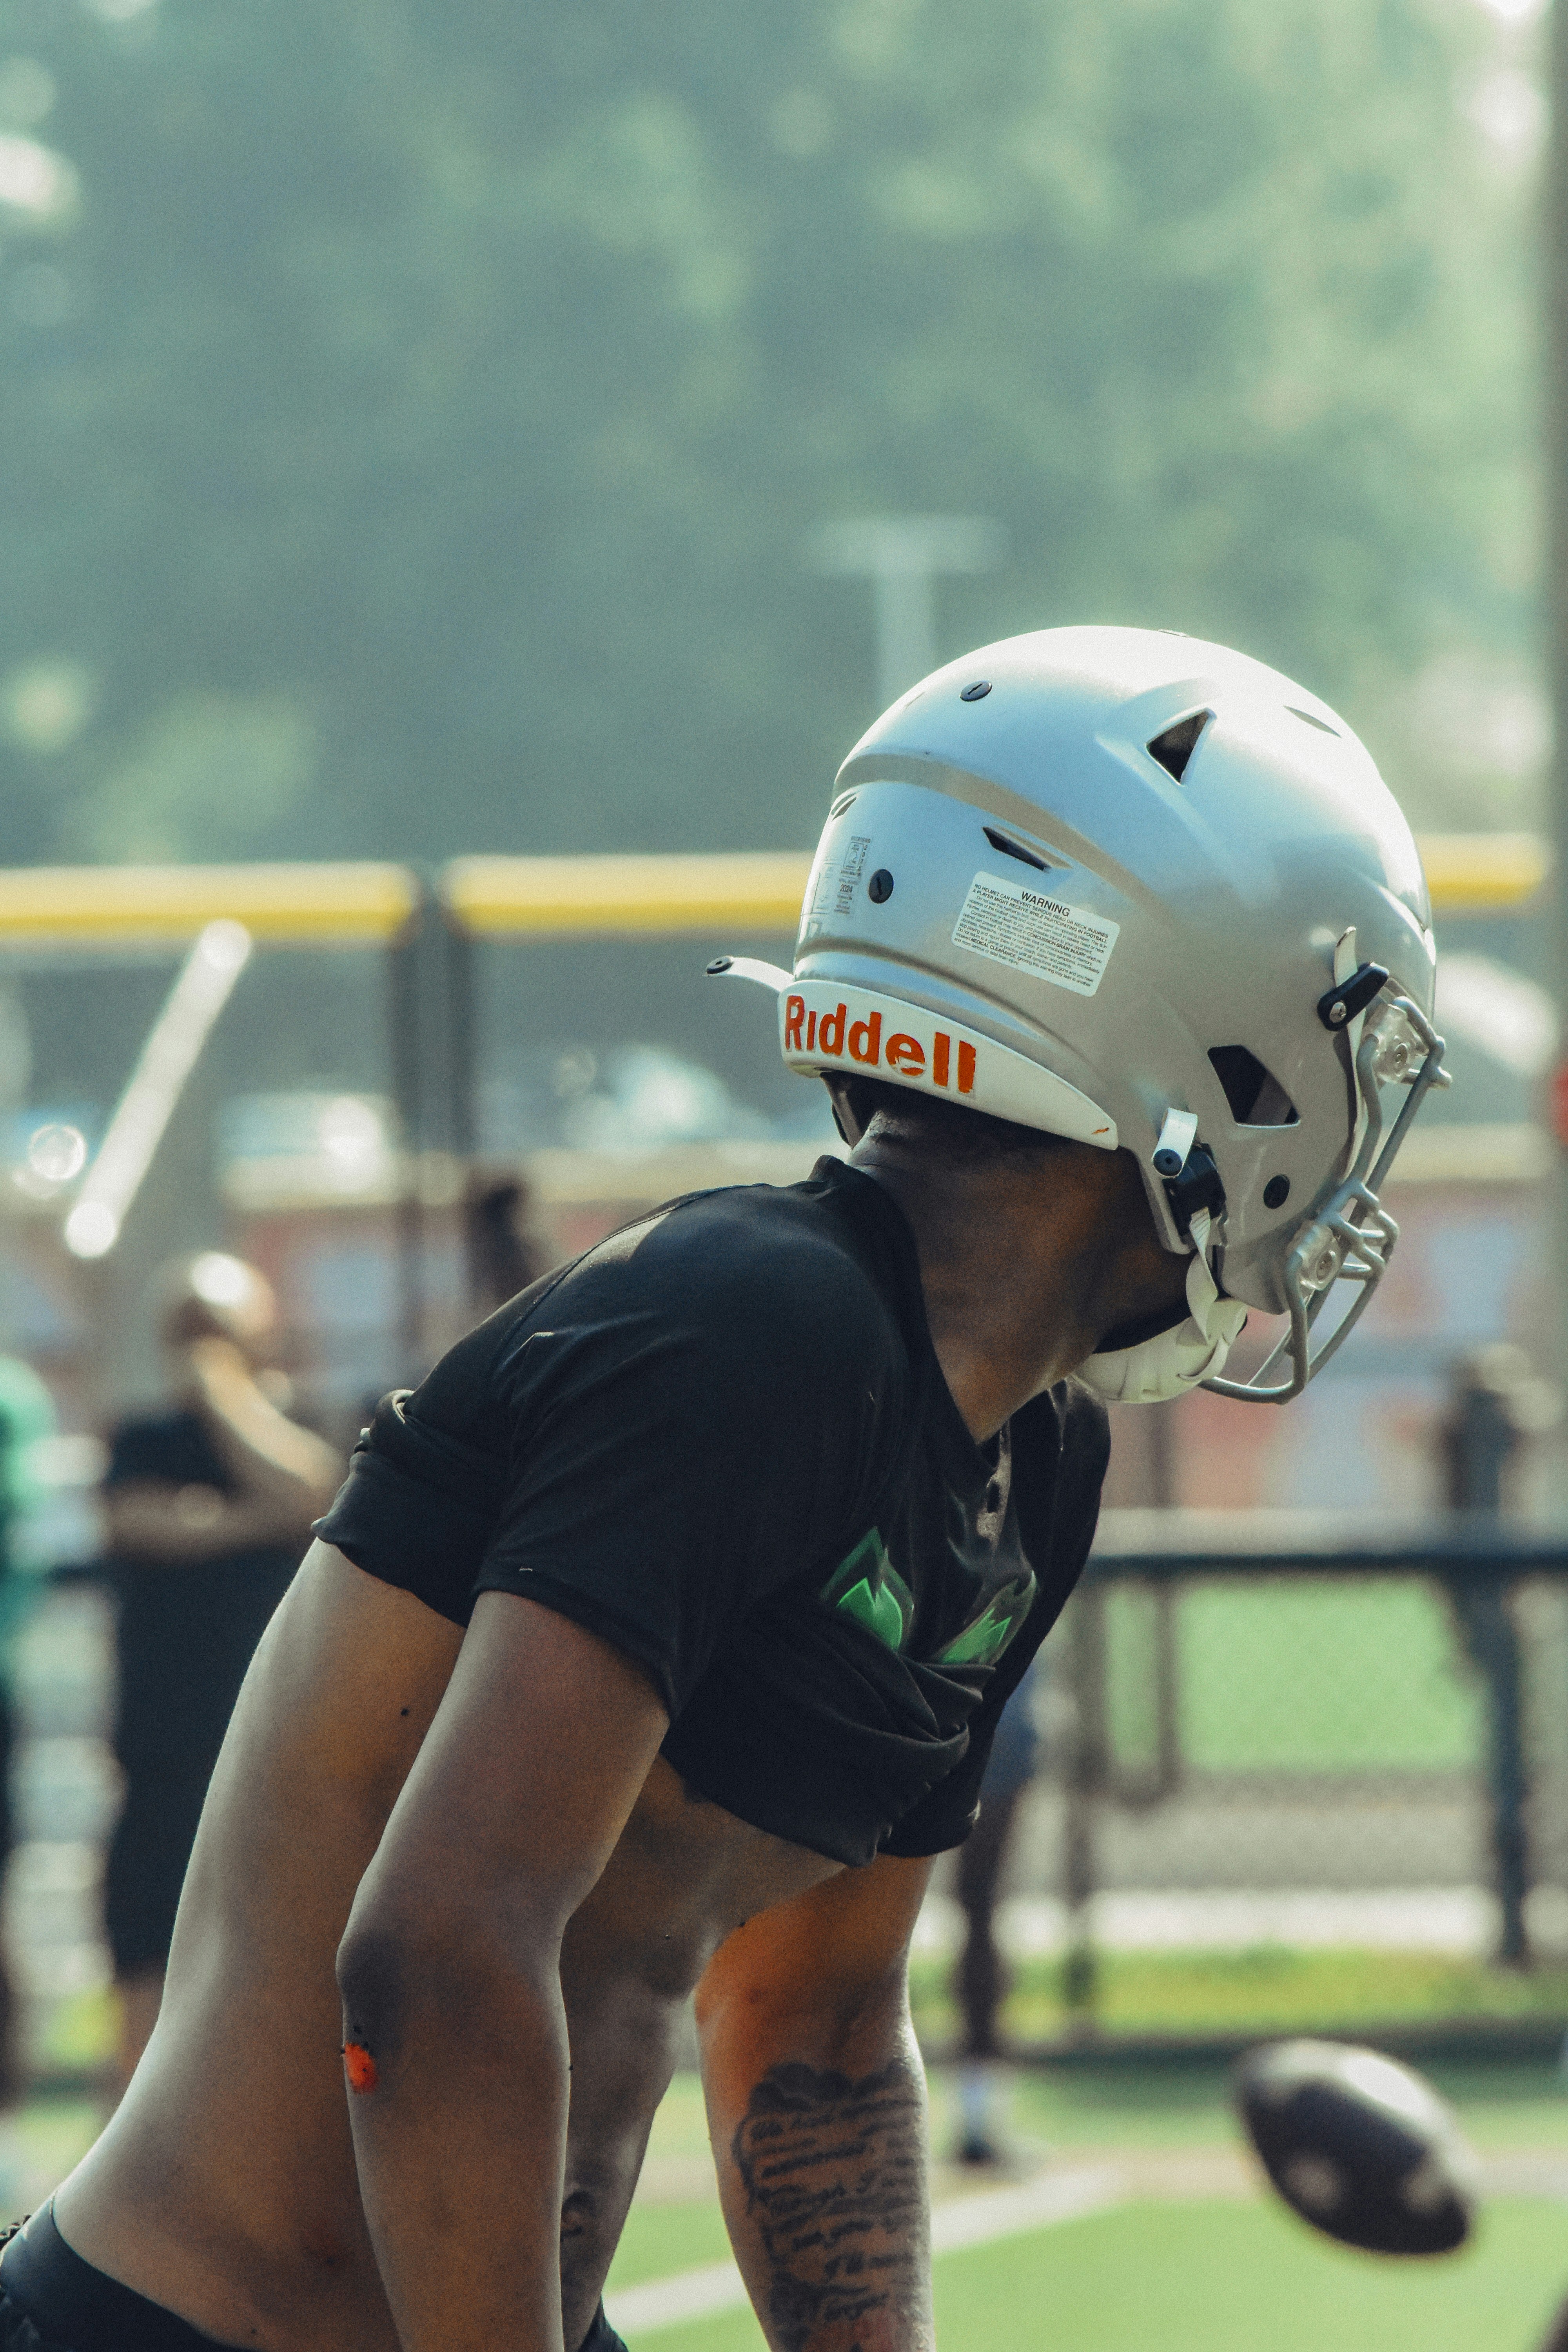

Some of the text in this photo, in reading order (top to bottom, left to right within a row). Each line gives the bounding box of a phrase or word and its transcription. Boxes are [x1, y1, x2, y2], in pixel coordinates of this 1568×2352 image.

[840, 884, 853, 893] 2024
[977, 890, 994, 899] PLAYER
[994, 897, 1008, 905] MIGHT
[1009, 903, 1028, 913] RECEIVE
[1029, 910, 1044, 918] WHILE
[1044, 916, 1077, 932] PARTICIPATING
[982, 886, 1000, 896] HELMET
[1011, 898, 1031, 908] PREVENT
[1033, 906, 1052, 916] SERIOUS
[1088, 927, 1108, 938] INJURIES
[1020, 891, 1071, 917] WARNING
[971, 938, 989, 947] MEDICAL
[1071, 949, 1085, 957] INJURY
[785, 995, 976, 1093] Riddell
